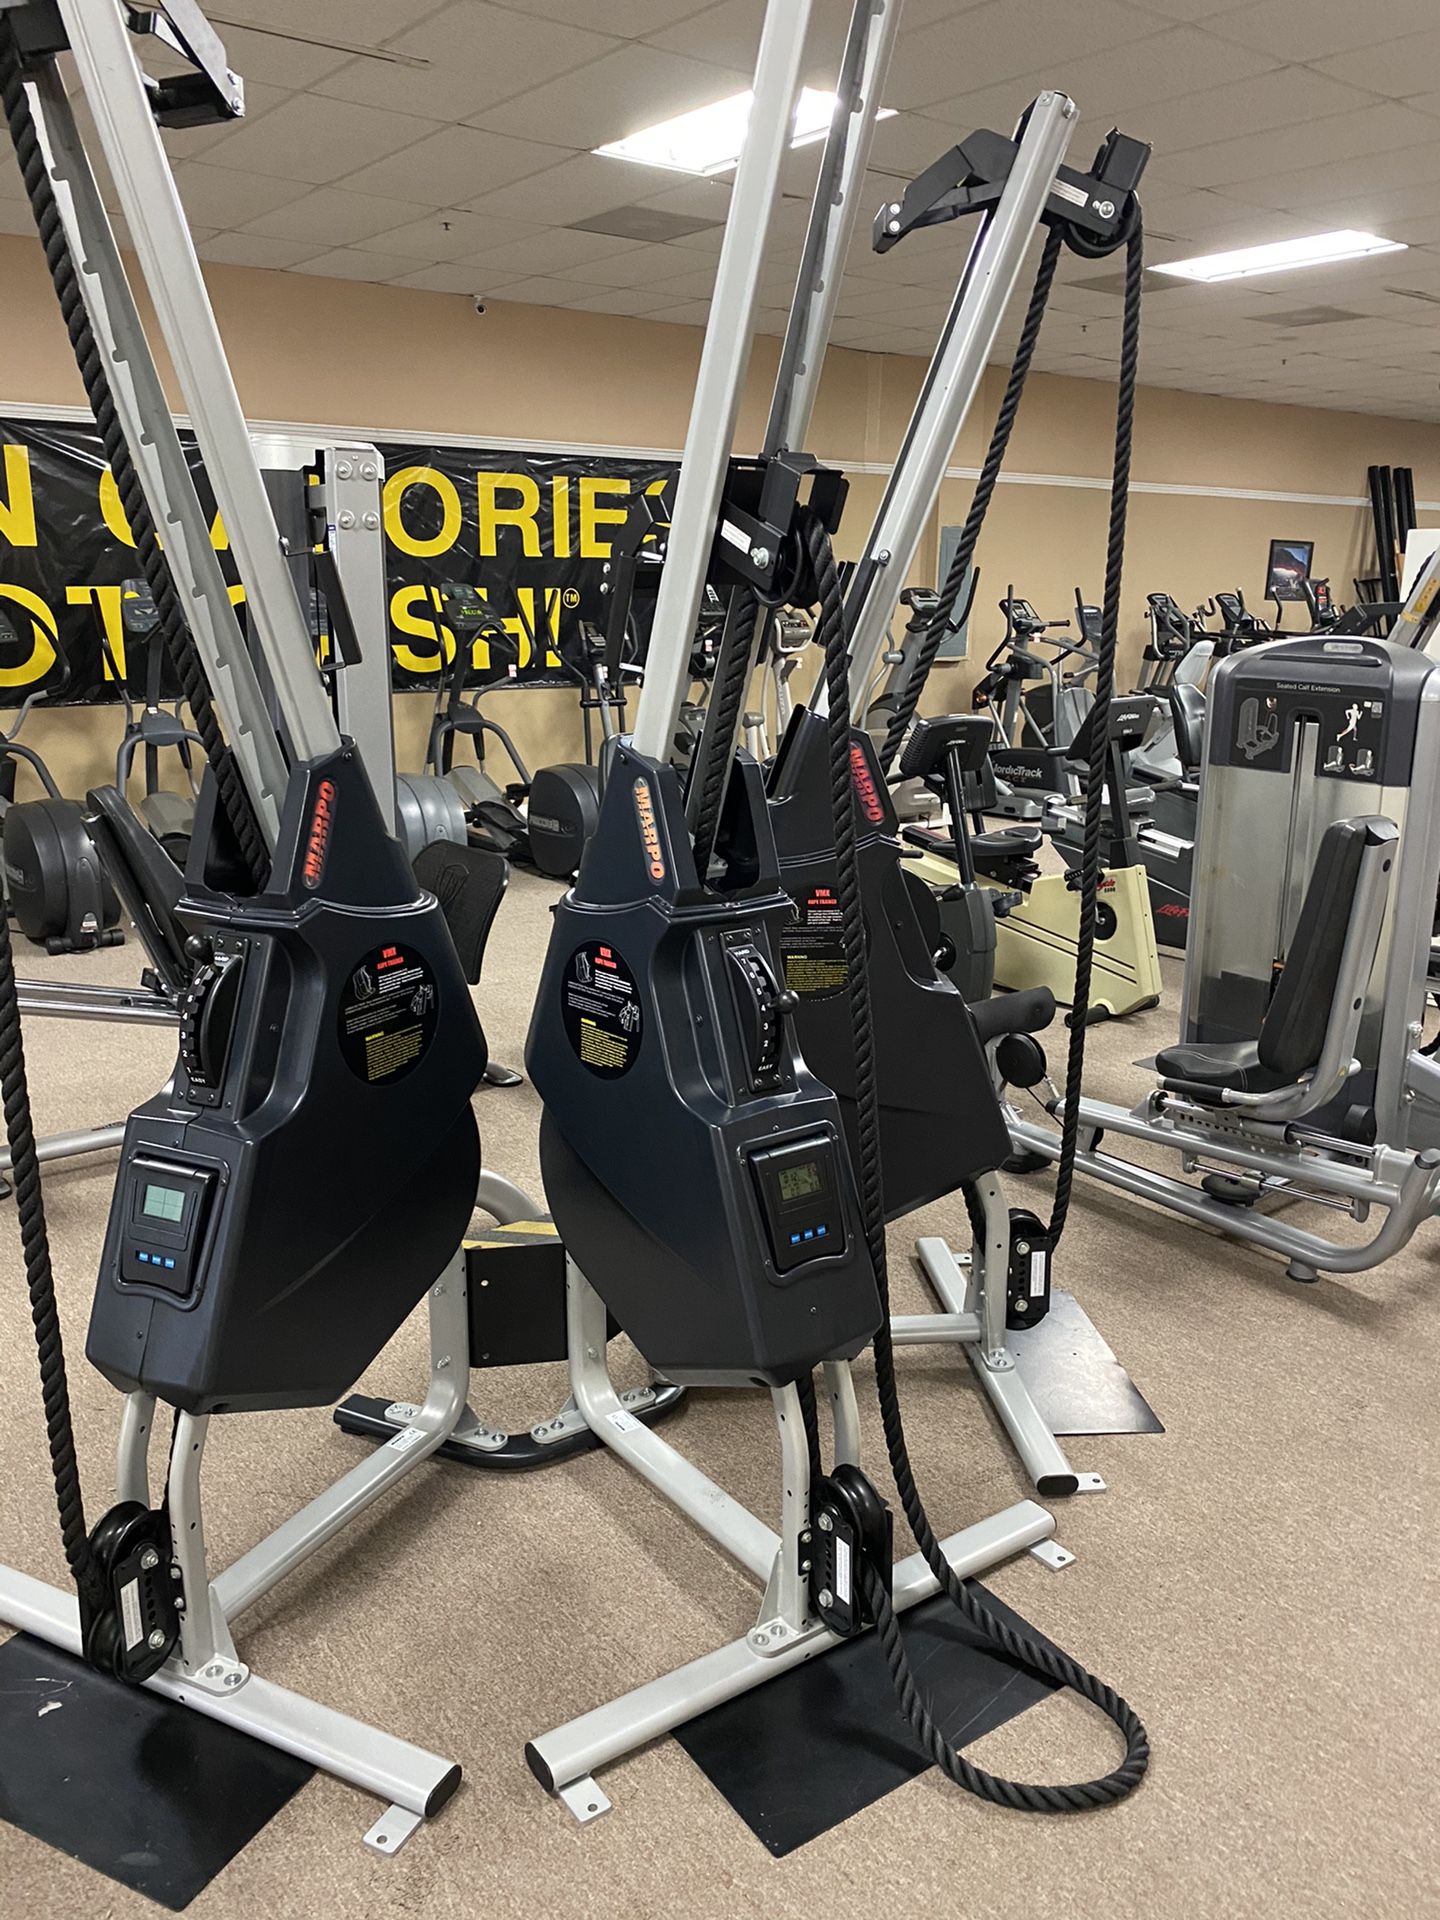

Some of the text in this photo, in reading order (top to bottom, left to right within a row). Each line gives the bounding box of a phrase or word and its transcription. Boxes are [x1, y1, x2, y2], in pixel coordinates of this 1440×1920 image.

[1276, 681, 1297, 690] Seated
[1310, 684, 1341, 693] Extension
[304, 780, 335, 881] MARPO
[634, 786, 665, 879] MARPO
[760, 1004, 767, 1012] 4
[763, 1022, 769, 1030] 3
[181, 1031, 187, 1039] 3
[763, 1040, 769, 1048] 2
[182, 1049, 188, 1058] 2
